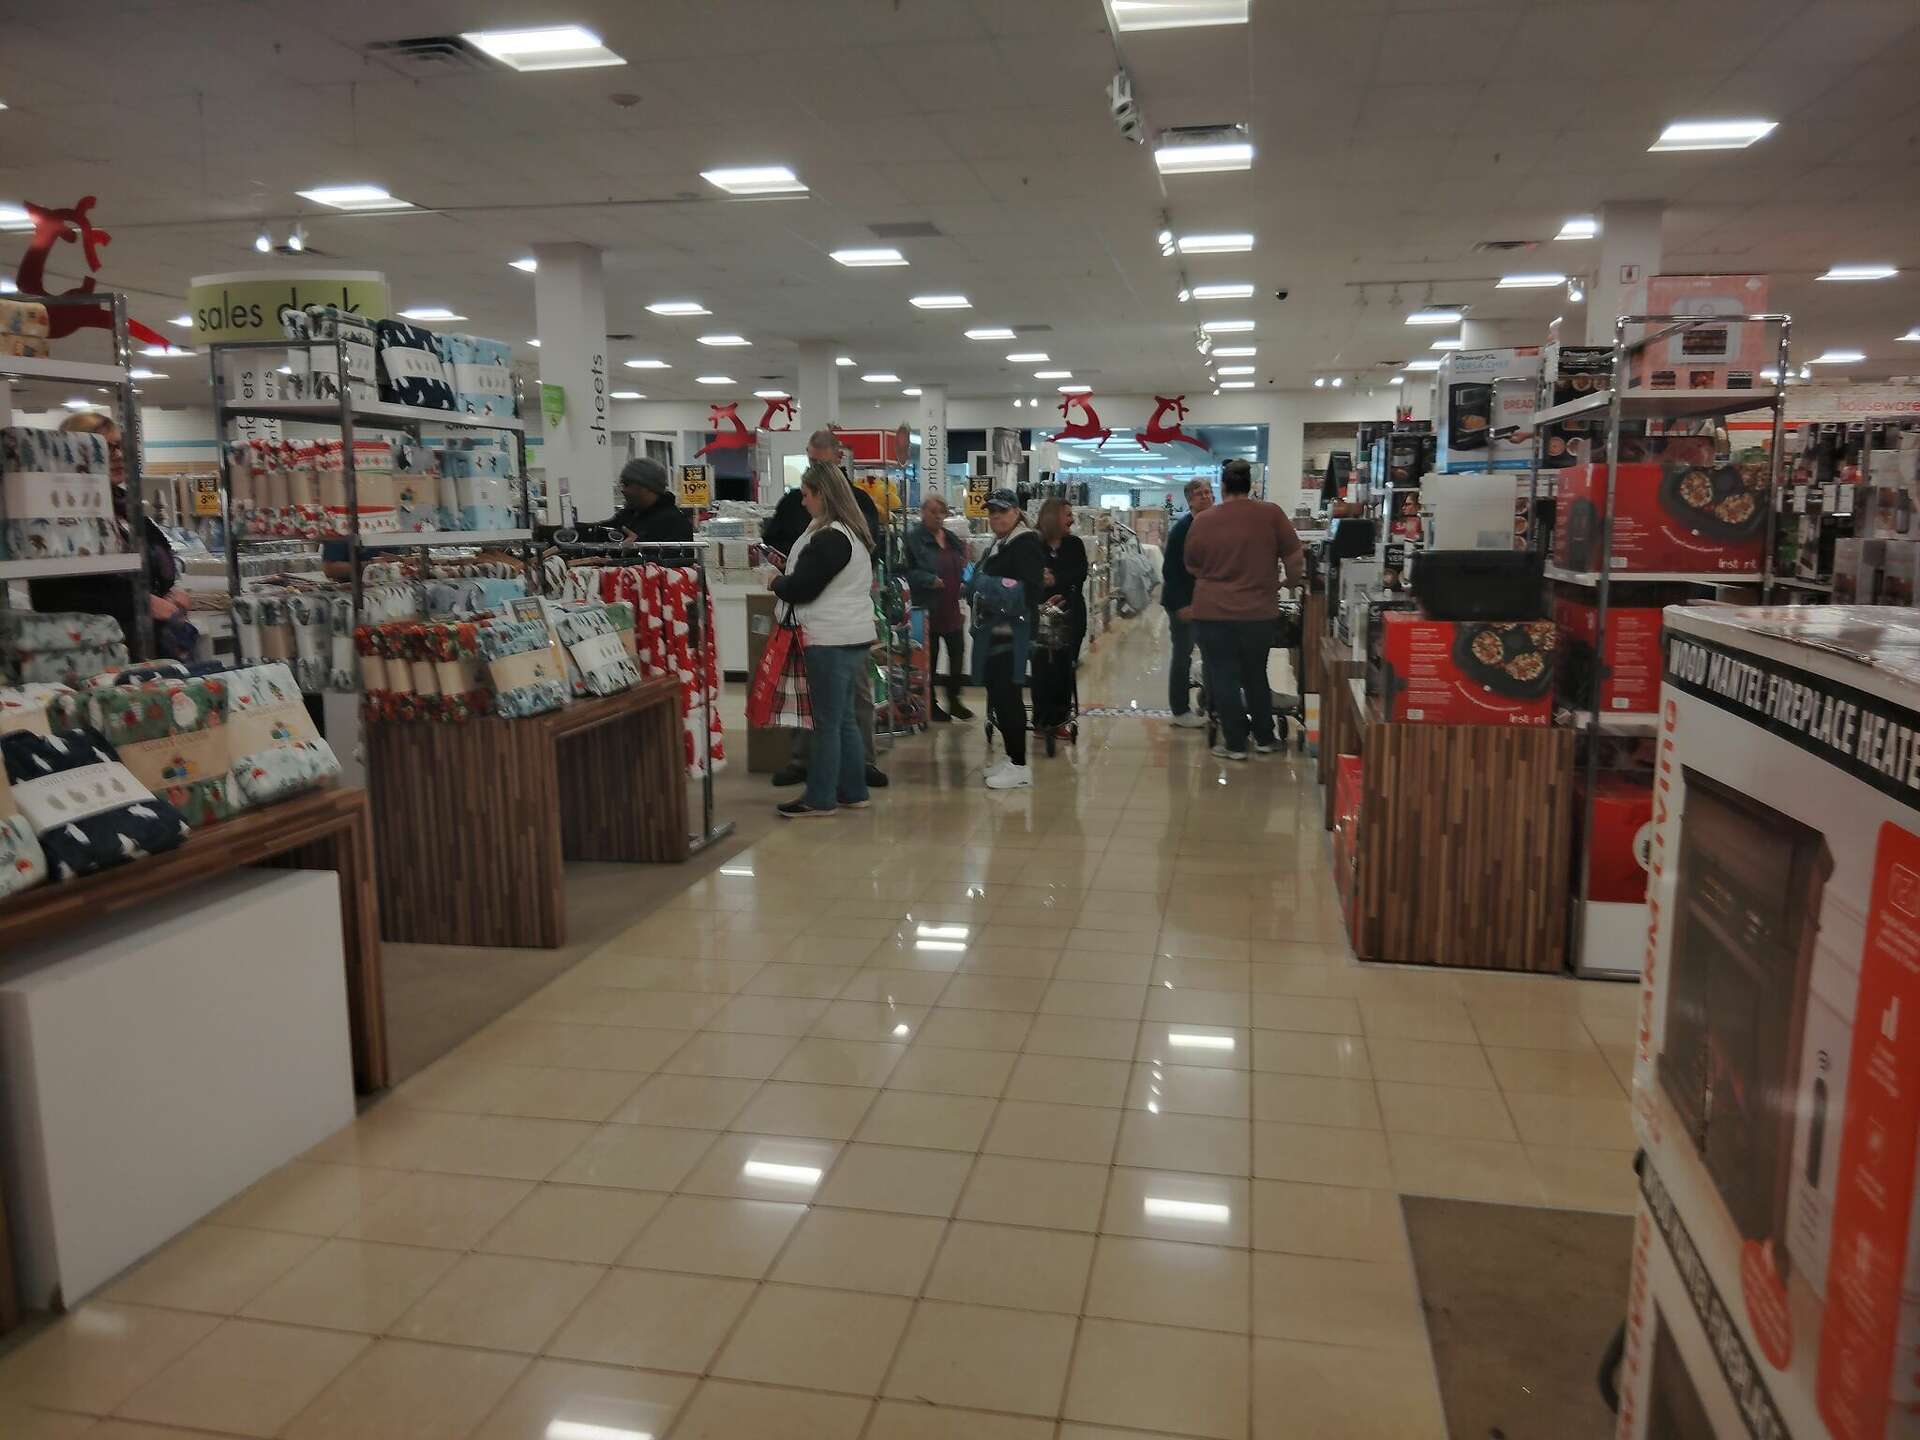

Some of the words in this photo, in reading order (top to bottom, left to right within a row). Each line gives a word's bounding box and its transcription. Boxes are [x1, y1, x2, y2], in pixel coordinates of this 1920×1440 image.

[198, 290, 263, 332] sales
[277, 287, 360, 326] dk
[590, 353, 607, 446] sheets
[1669, 638, 1708, 685] WOOD
[1706, 651, 1764, 711] MANTEL
[1765, 674, 1857, 754] FIREPLACE
